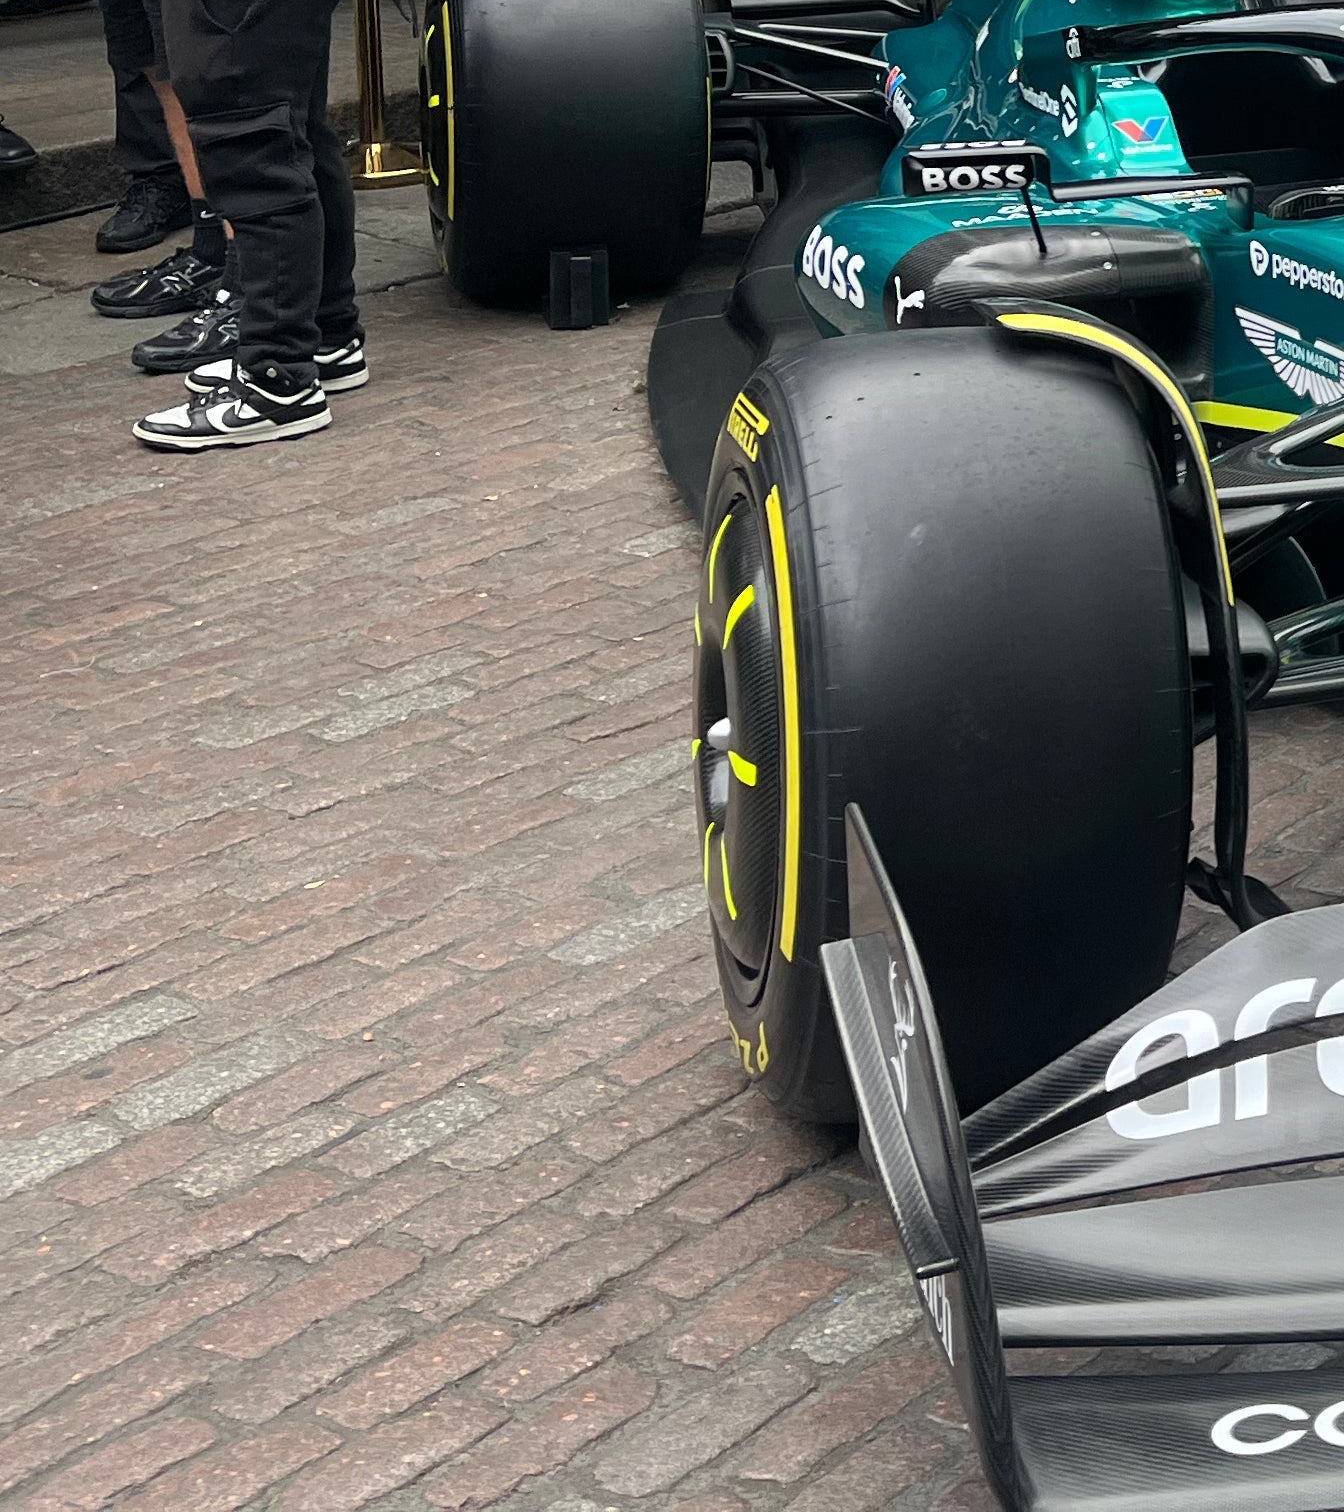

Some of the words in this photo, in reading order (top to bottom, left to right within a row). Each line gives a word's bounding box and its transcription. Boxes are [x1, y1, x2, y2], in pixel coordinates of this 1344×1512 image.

[921, 164, 1027, 192] BOSS
[802, 223, 866, 310] BOSS
[1276, 338, 1305, 361] ASTON
[1306, 349, 1339, 377] MARTIN
